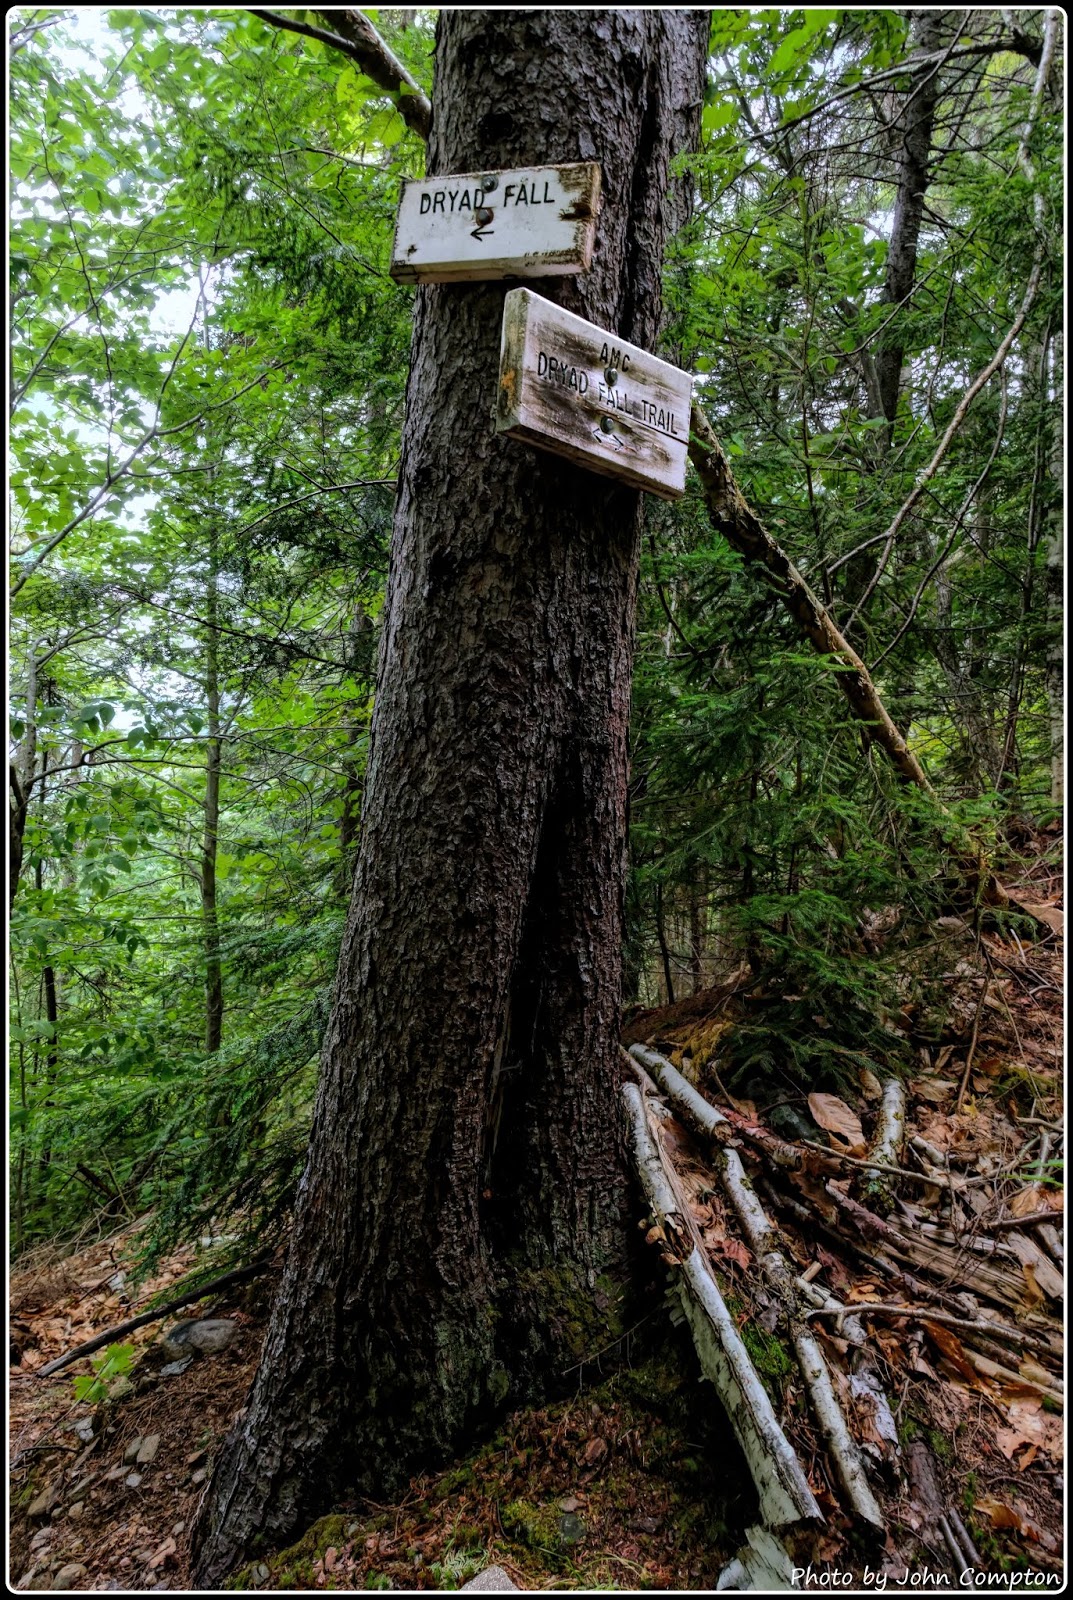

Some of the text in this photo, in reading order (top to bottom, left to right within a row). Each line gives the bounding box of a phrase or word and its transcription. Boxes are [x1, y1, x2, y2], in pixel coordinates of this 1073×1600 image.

[419, 182, 555, 214] DRYAD FALL
[599, 342, 631, 372] AMC
[537, 351, 678, 434] DRYAD FALL TRAIL
